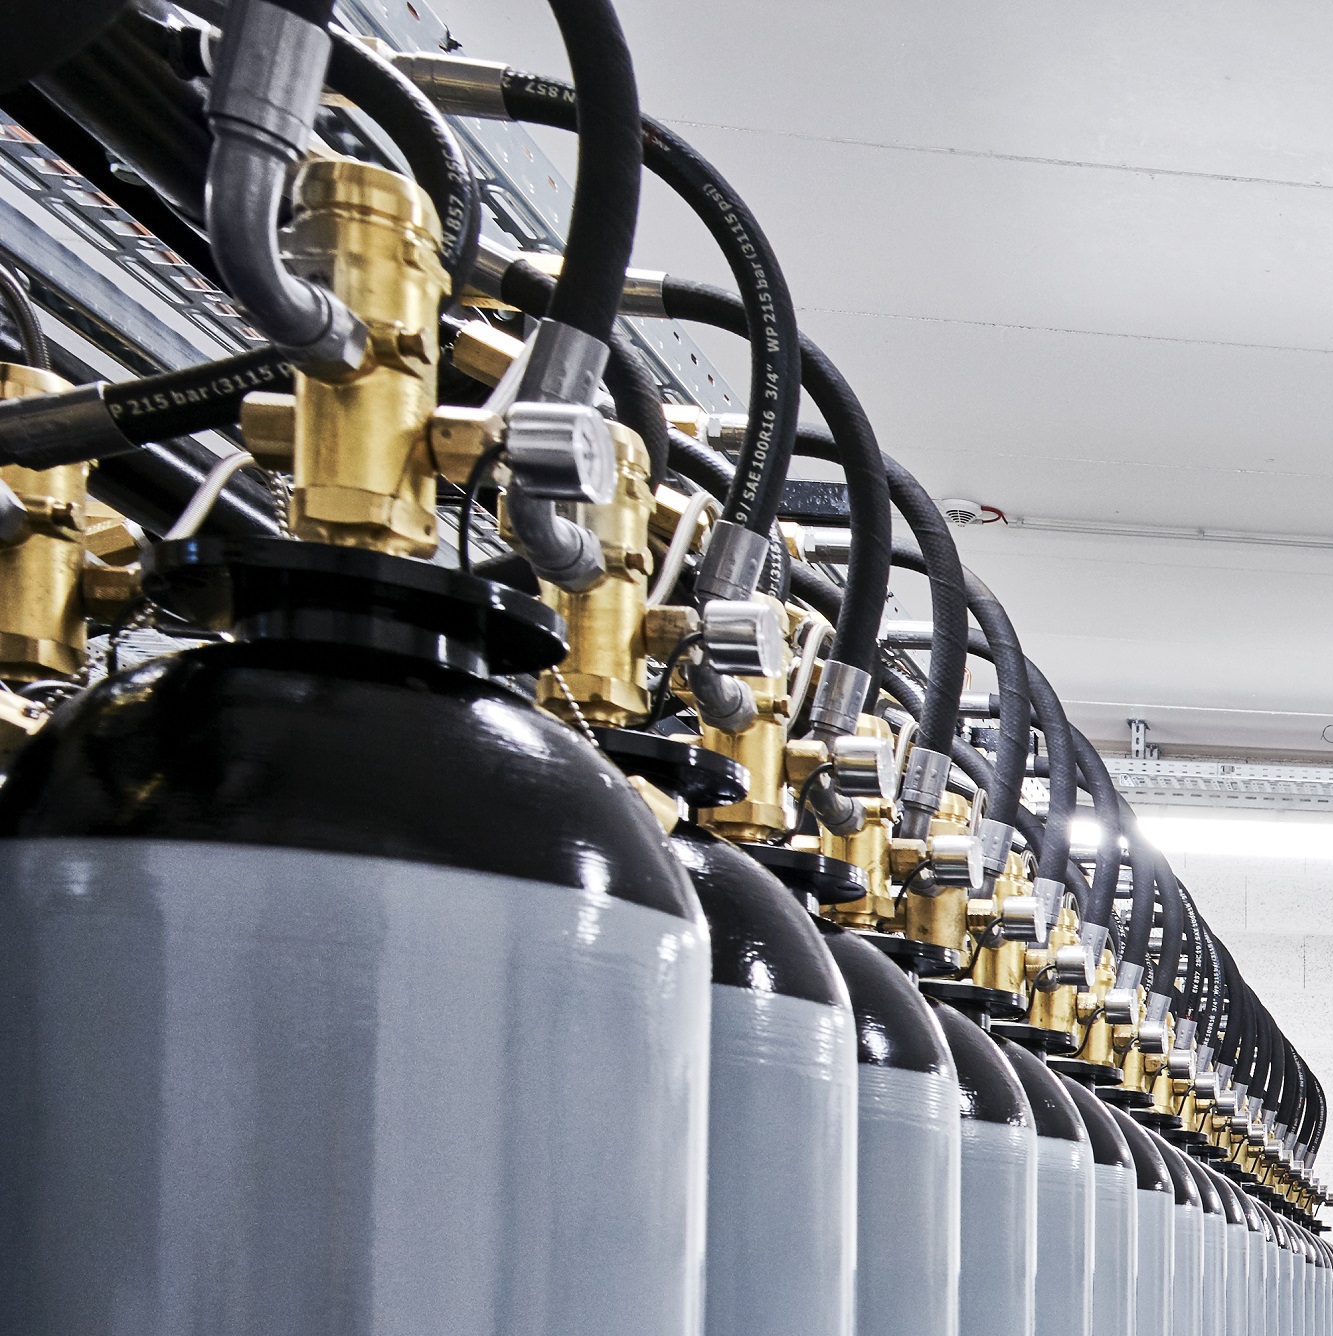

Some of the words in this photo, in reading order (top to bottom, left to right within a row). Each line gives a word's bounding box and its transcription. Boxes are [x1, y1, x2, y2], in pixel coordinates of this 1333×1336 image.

[524, 81, 560, 99] 857
[446, 195, 465, 229] 857
[702, 183, 733, 212] psi)
[725, 212, 758, 260] (3115
[751, 262, 770, 290] bar
[759, 292, 776, 323] 215
[766, 327, 780, 353] WP
[126, 393, 170, 416] 215
[171, 385, 210, 406] bar
[211, 364, 276, 396] (3115
[752, 409, 776, 471] 100R16
[743, 470, 762, 502] SAE
